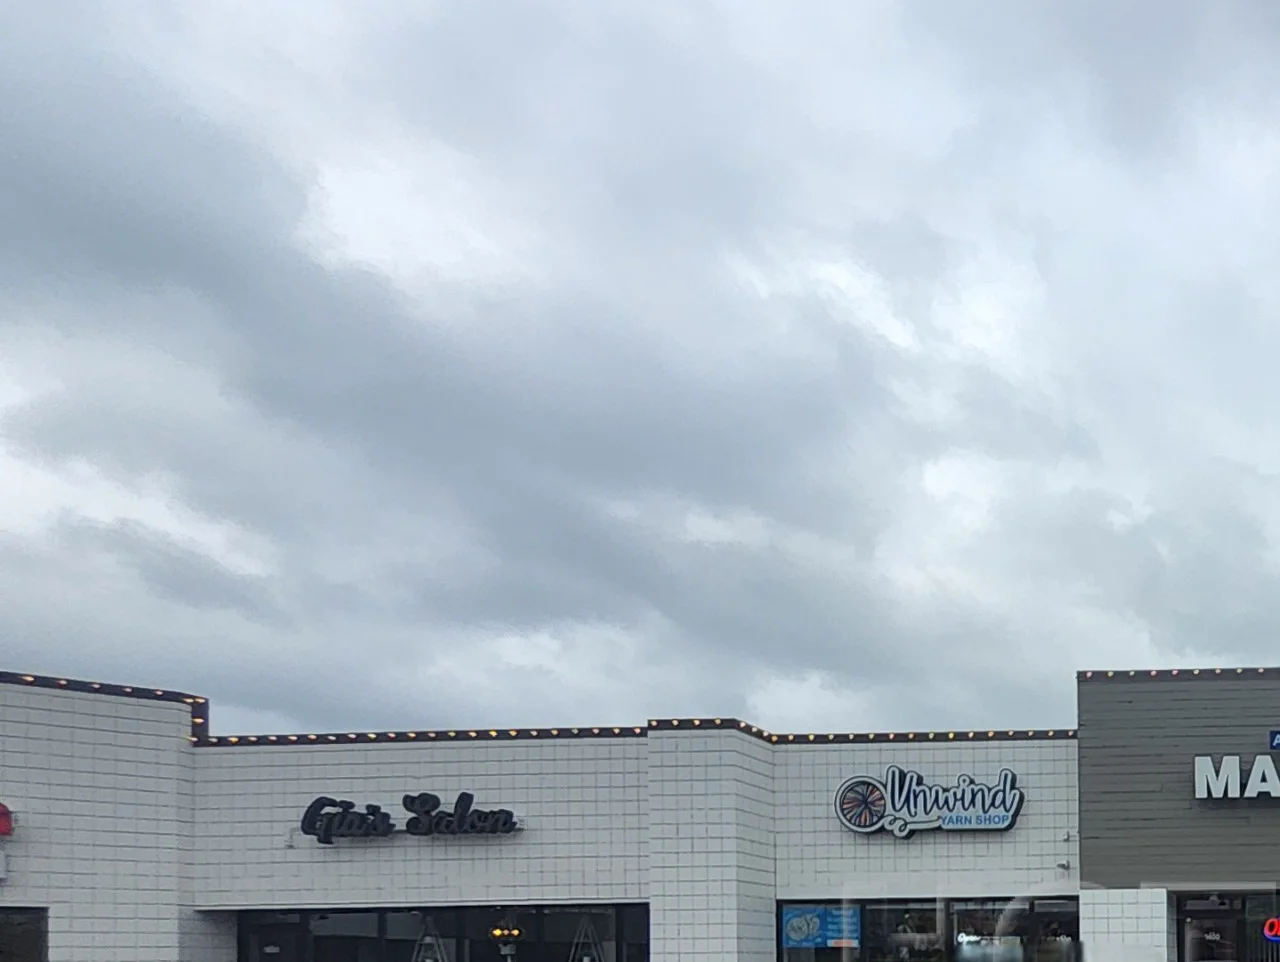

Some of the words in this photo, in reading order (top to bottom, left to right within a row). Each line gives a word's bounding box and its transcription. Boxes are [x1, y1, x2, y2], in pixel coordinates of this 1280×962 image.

[301, 796, 396, 845] Gia's
[402, 791, 518, 836] Salon
[887, 765, 1021, 819] Unwind
[940, 814, 972, 826] YARN
[977, 813, 1011, 826] SHOP
